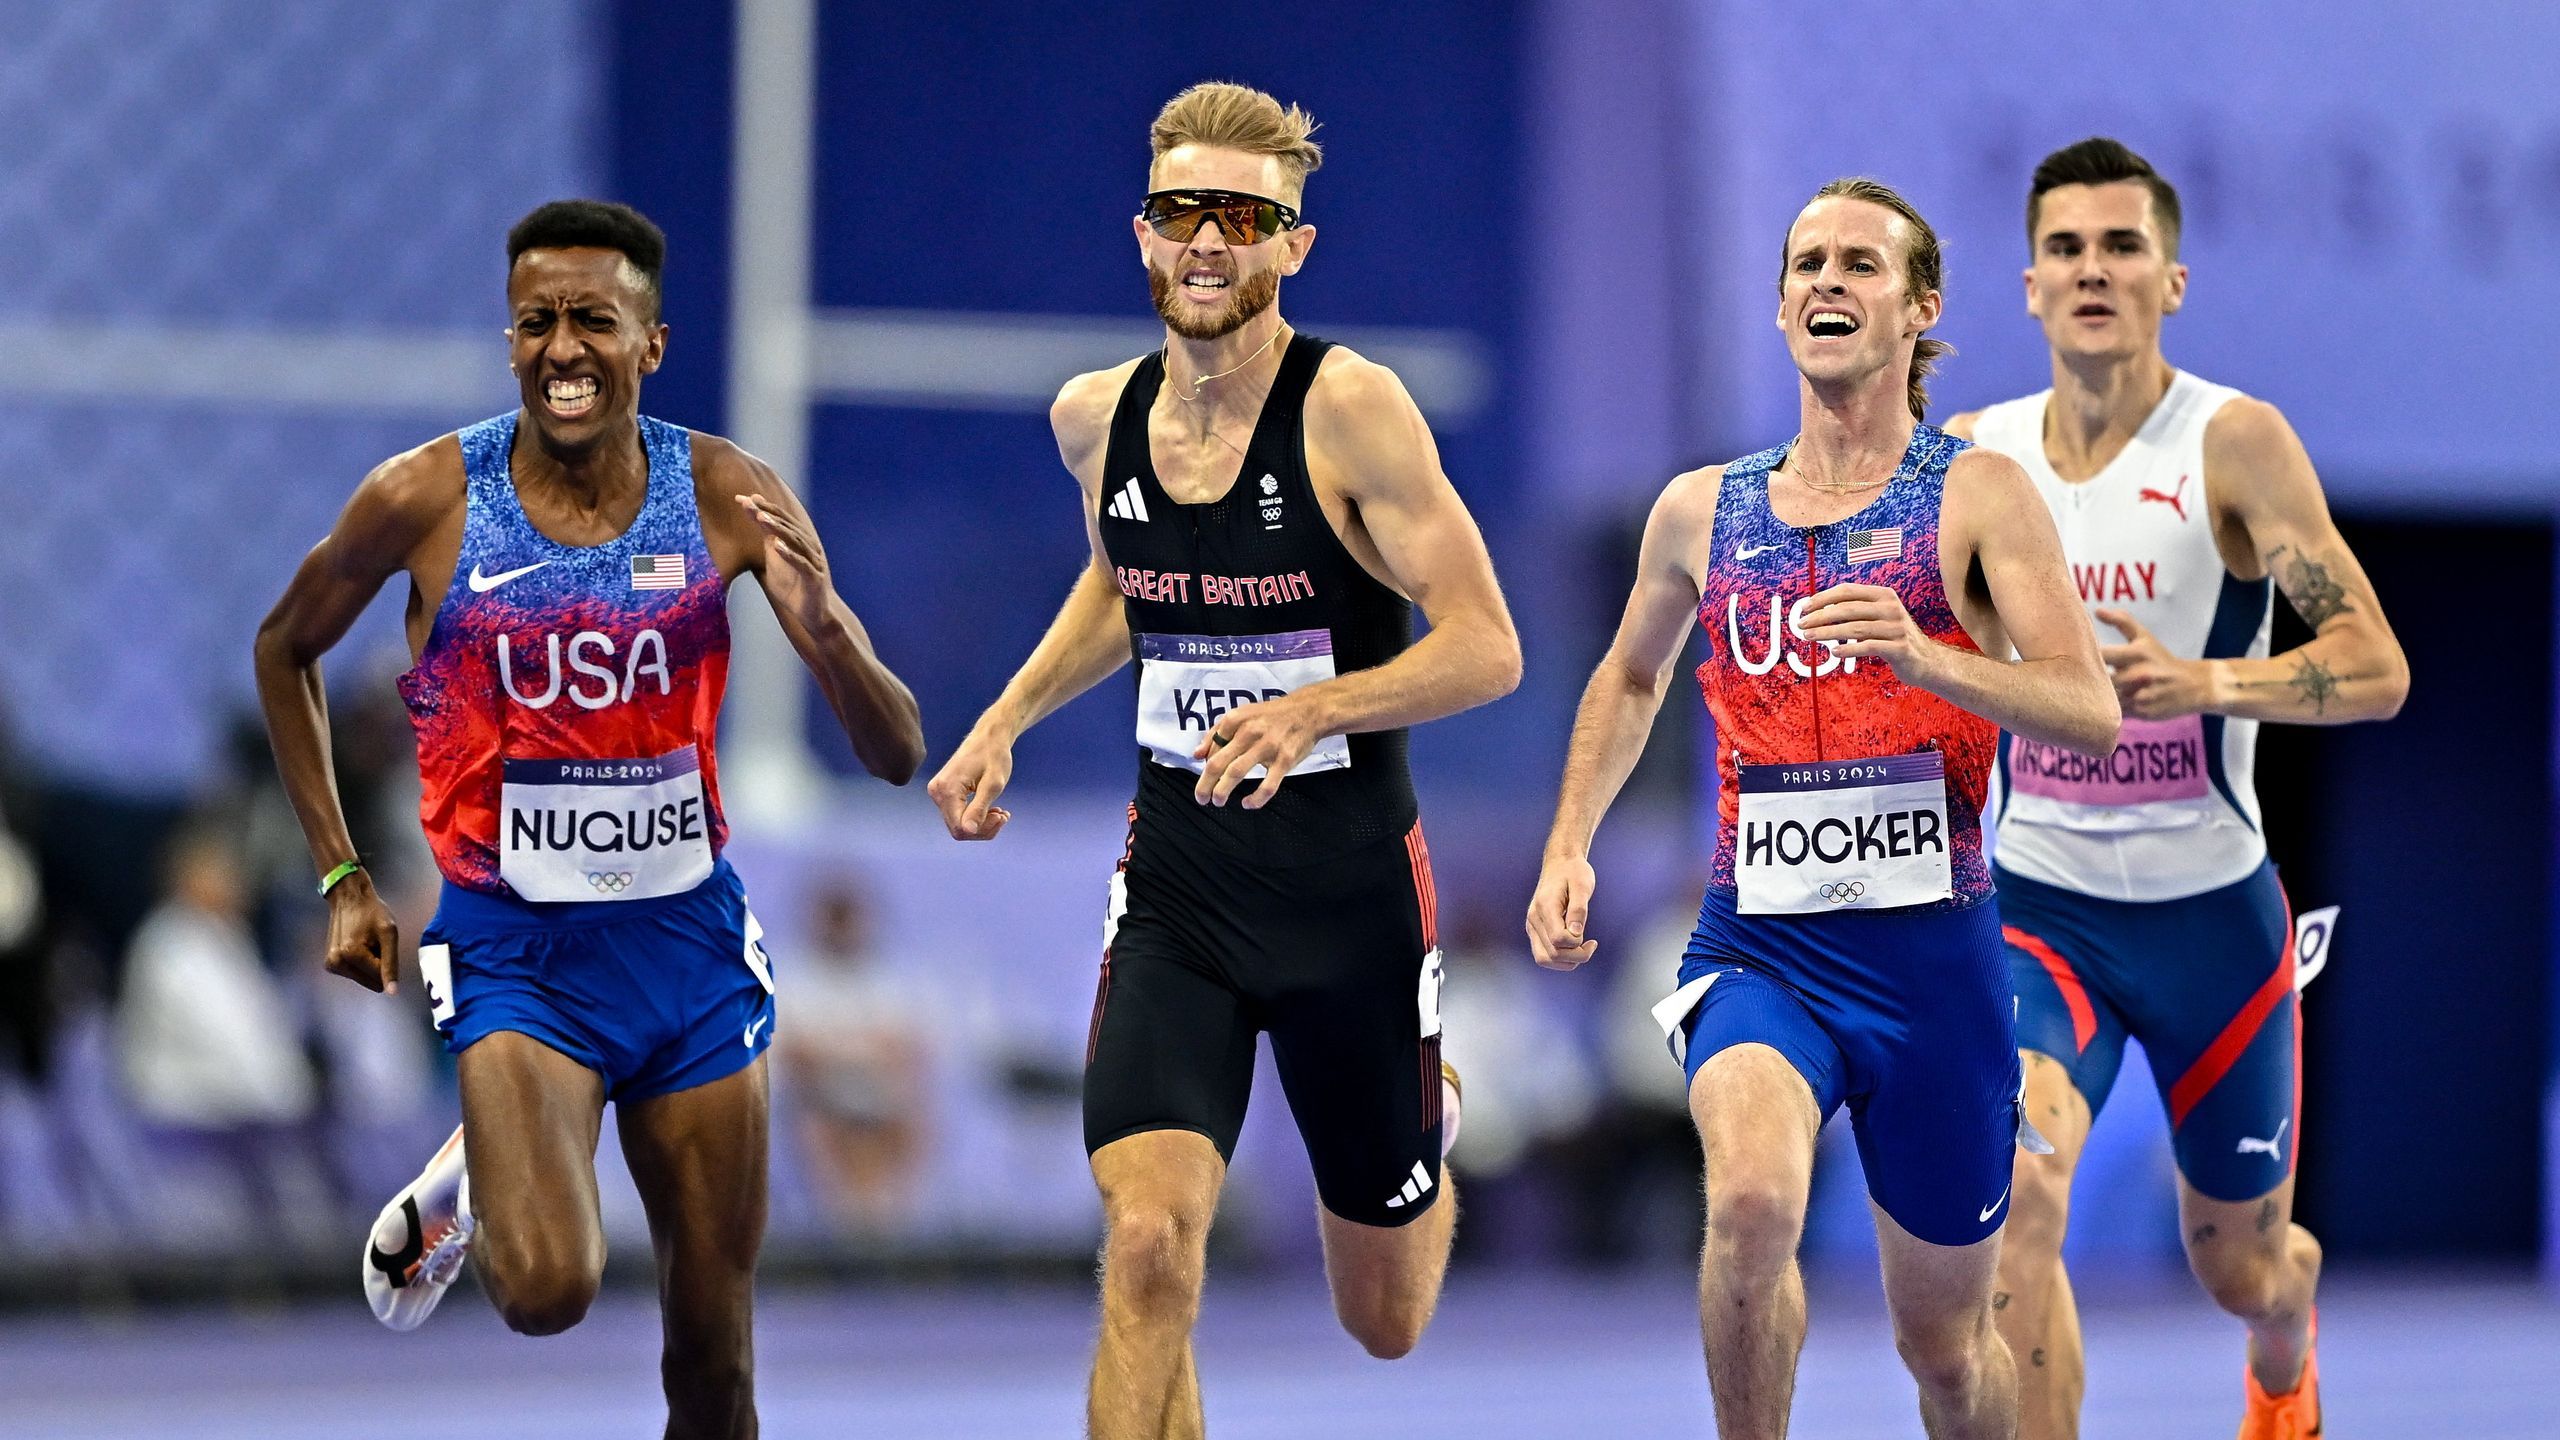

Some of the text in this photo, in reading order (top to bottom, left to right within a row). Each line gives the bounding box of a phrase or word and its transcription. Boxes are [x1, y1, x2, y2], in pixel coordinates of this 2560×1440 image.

[1117, 566, 1315, 607] GREAT BRITAIN
[2073, 561, 2157, 602] WAY
[497, 629, 670, 709] USA
[1230, 642, 1274, 655] 2024
[1173, 688, 1289, 731] KE
[561, 764, 663, 779] PARIS 2024
[1838, 765, 1887, 781] 2024
[511, 796, 702, 853] NUGUSE
[1745, 809, 1944, 867] HOCKER
